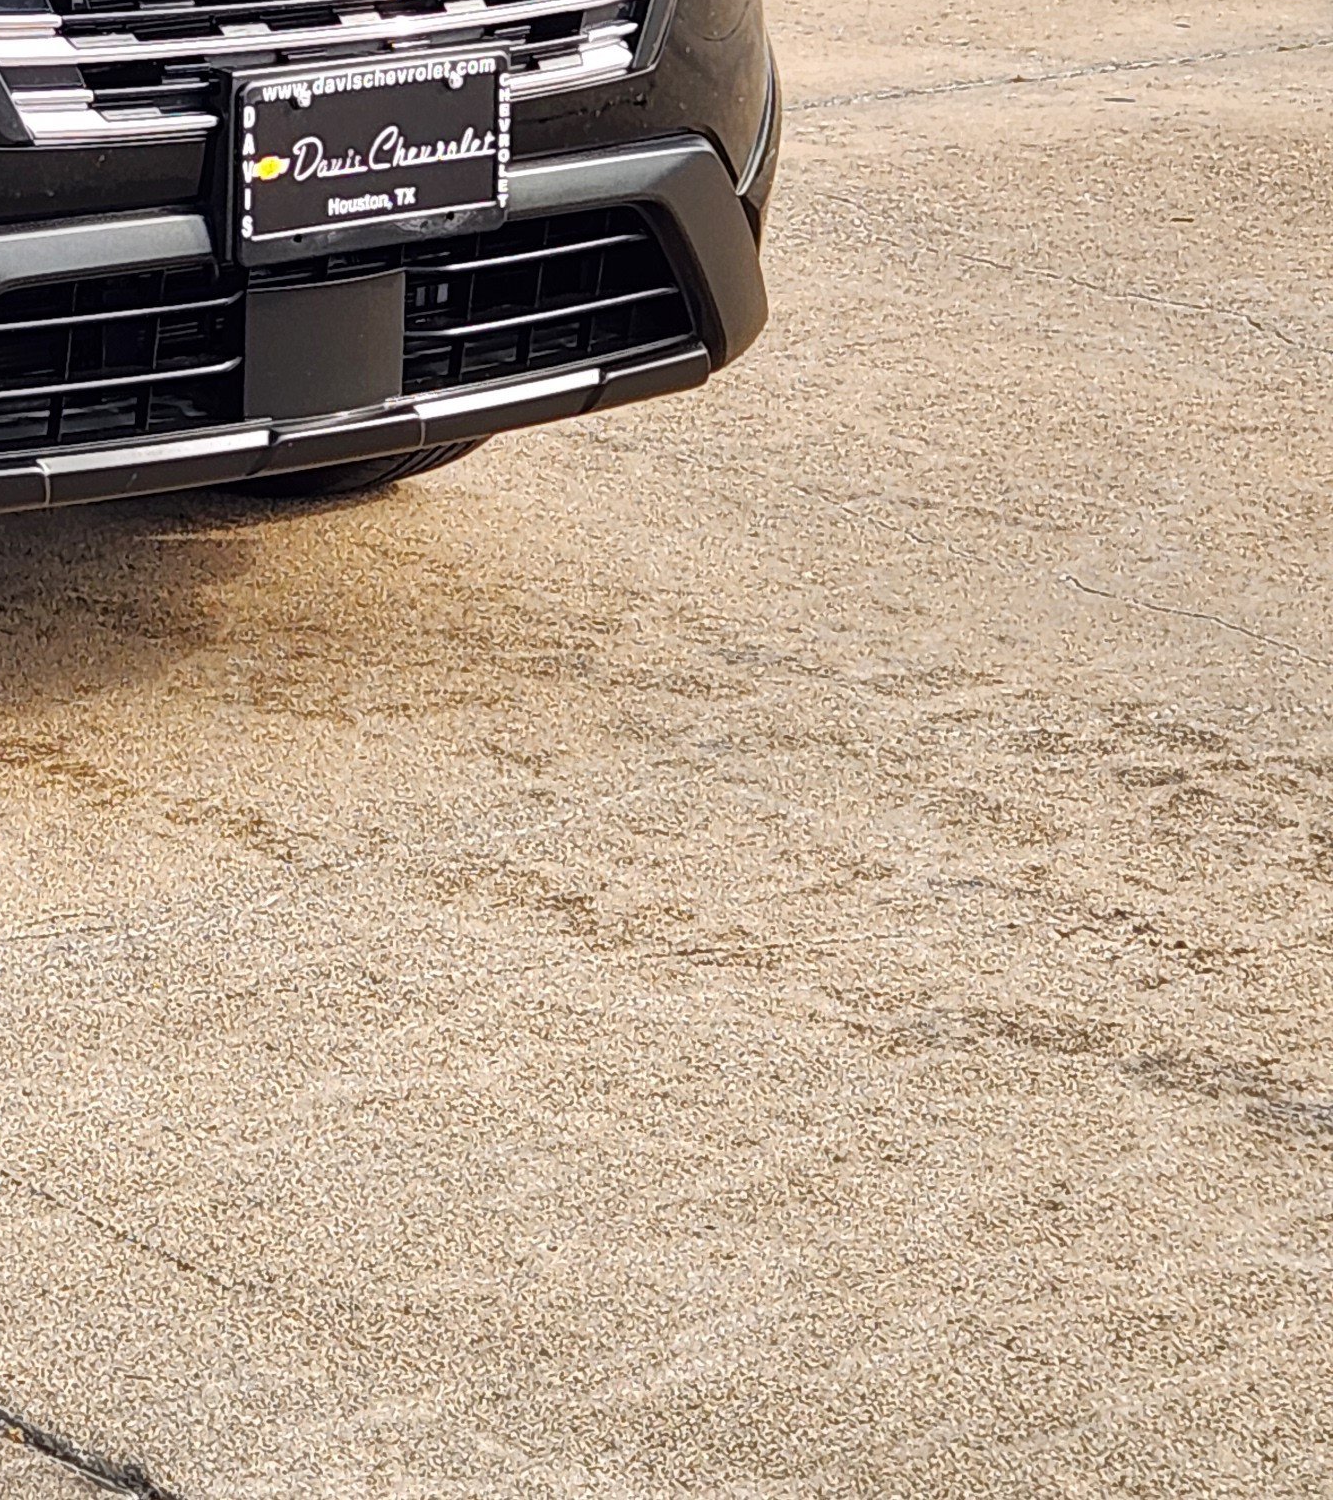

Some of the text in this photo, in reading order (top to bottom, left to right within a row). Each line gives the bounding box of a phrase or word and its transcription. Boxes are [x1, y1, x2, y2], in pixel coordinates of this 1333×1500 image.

[262, 58, 496, 101] www.davischevrolet.com
[292, 125, 497, 182] Davis Chevrolet
[497, 72, 512, 208] CHEVROLET
[241, 105, 256, 238] DAVIS
[327, 186, 417, 217] Houston, TX
